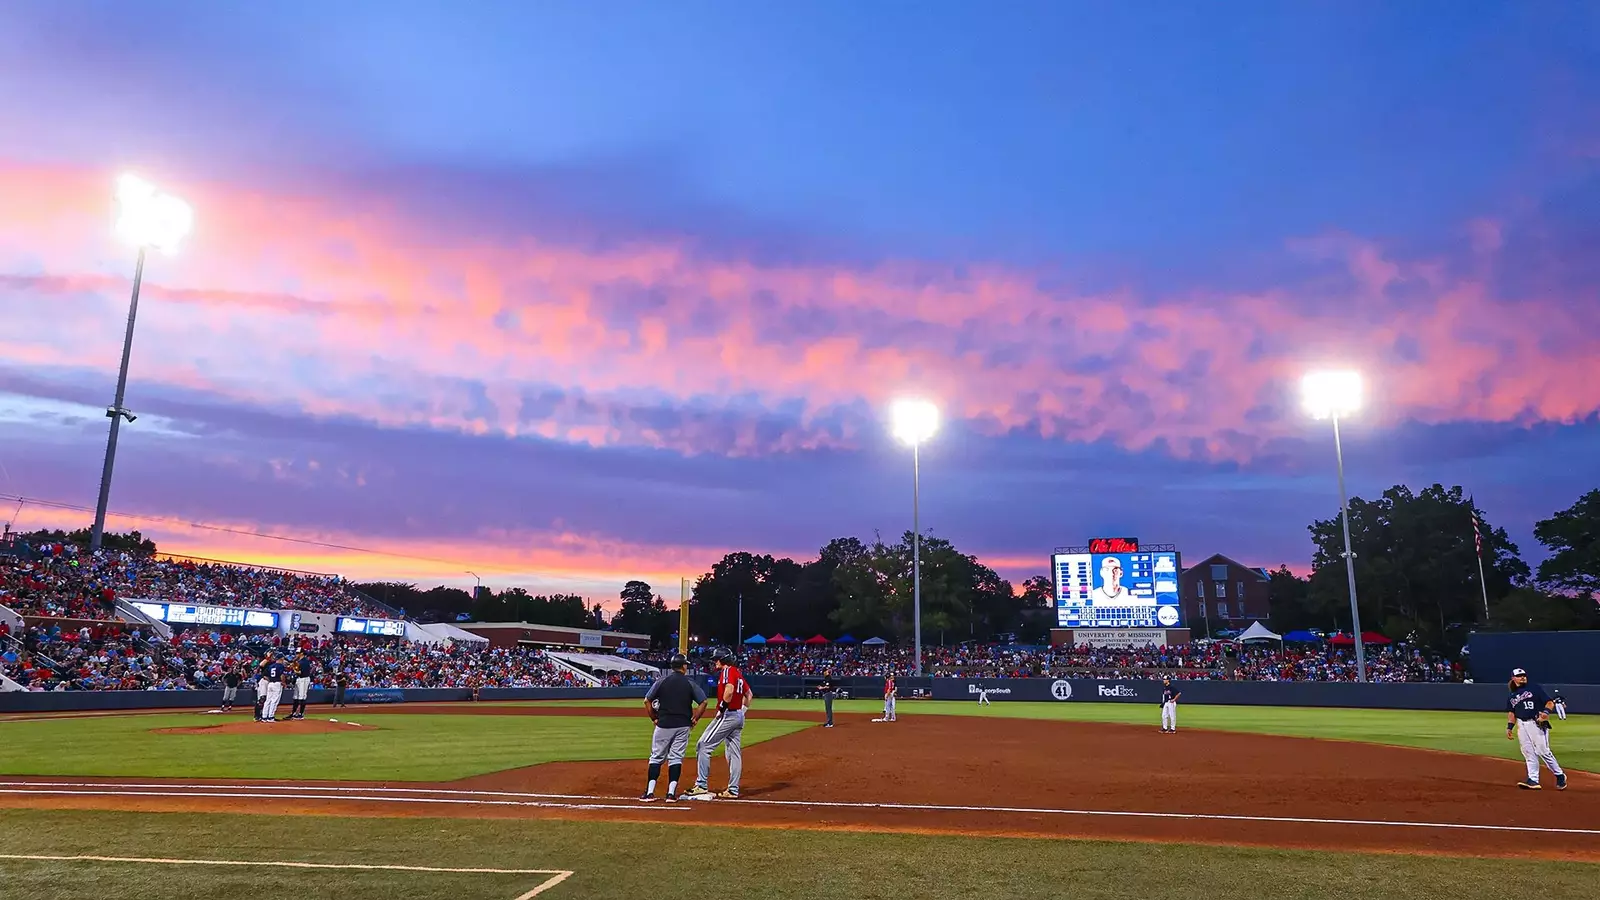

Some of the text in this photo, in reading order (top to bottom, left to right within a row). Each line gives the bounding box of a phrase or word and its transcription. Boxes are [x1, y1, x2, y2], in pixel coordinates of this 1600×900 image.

[1090, 538, 1137, 553] Ole Miss
[270, 668, 277, 677] 5
[1055, 686, 1068, 697] 41
[1523, 701, 1534, 710] 19
